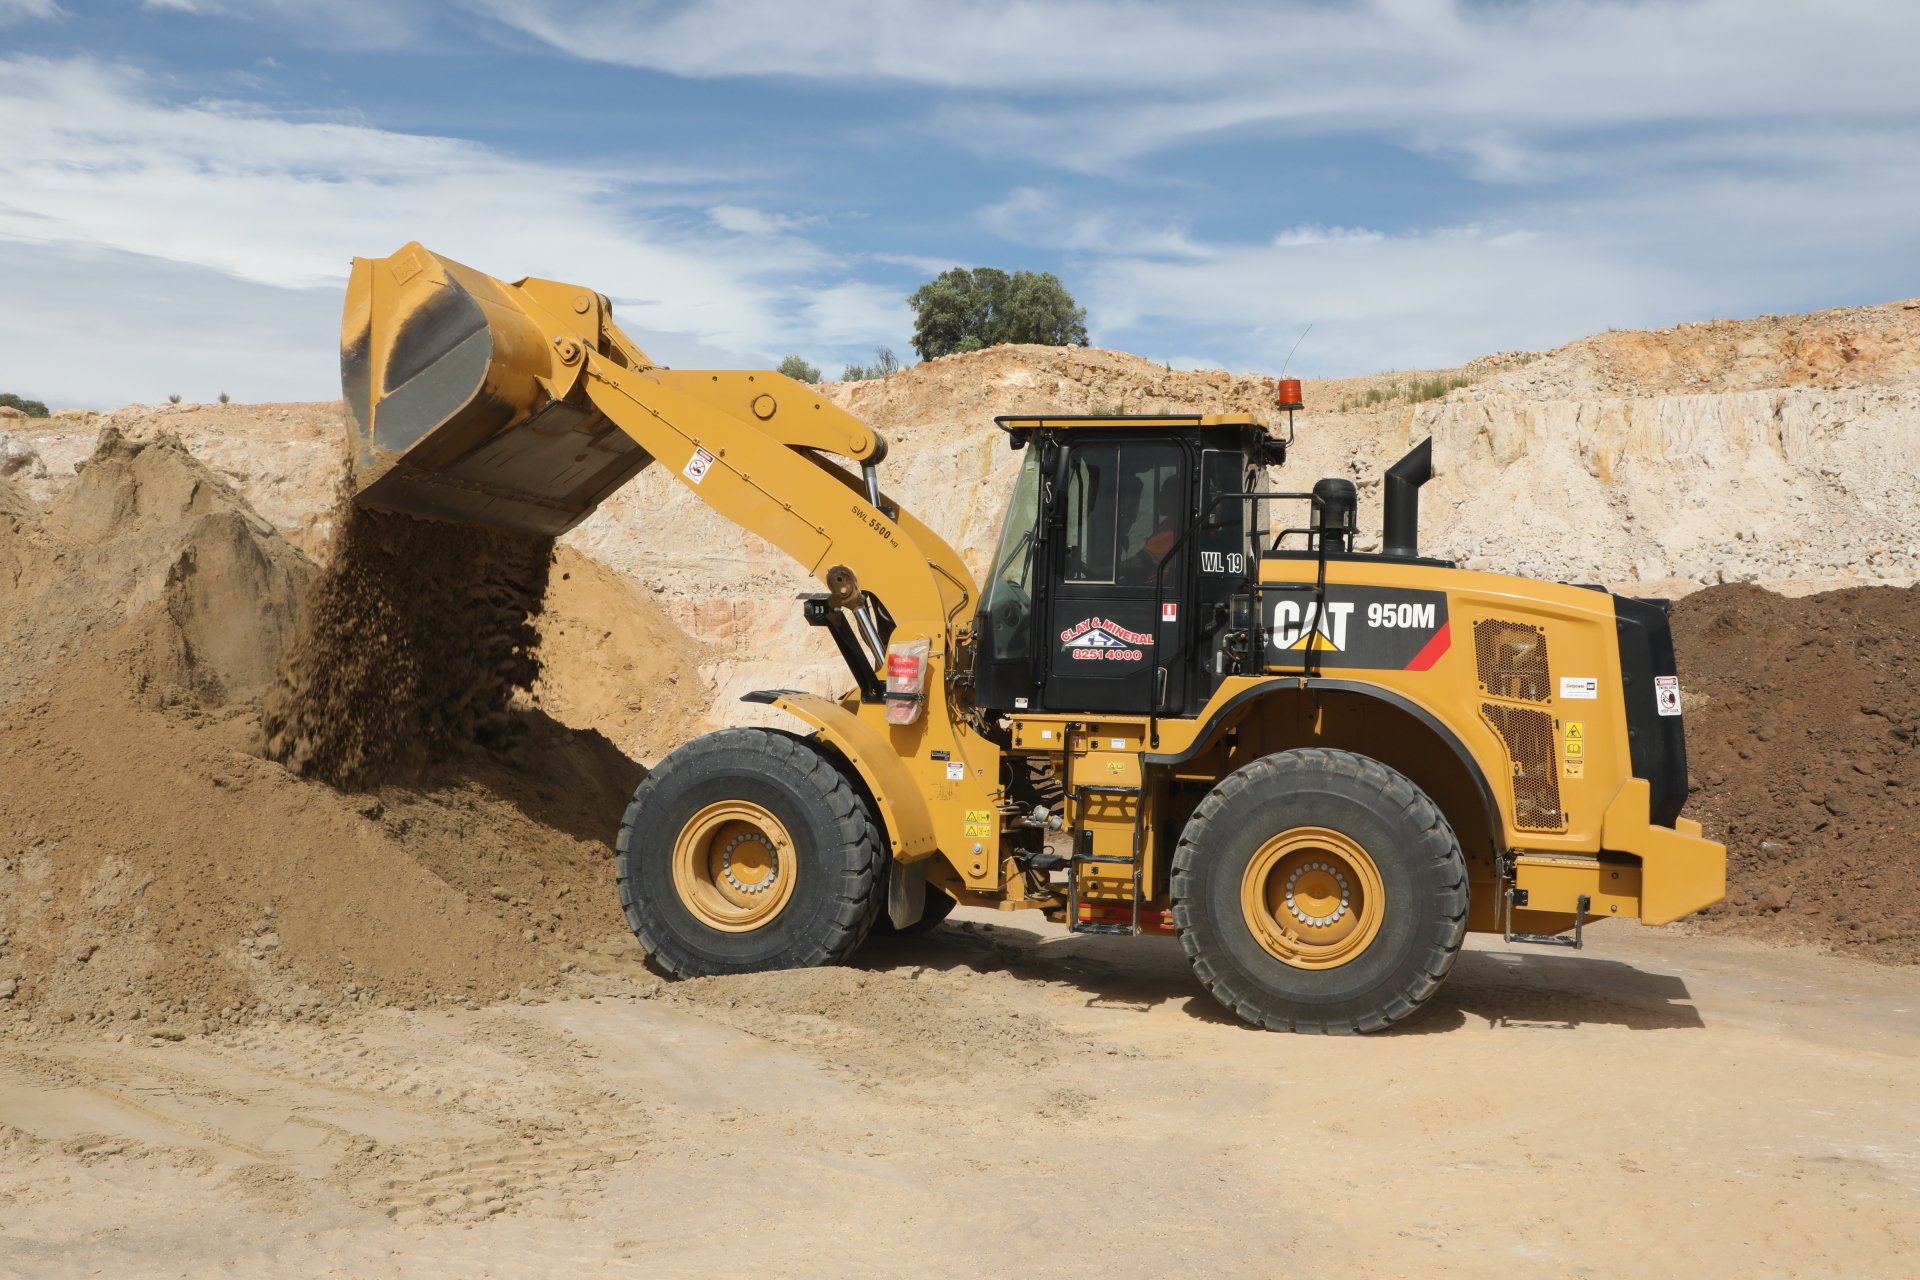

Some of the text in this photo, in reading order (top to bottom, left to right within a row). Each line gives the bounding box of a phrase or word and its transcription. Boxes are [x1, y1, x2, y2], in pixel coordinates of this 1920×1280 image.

[851, 505, 899, 548] SWL 5500 kg
[1201, 551, 1243, 574] WL 19
[1060, 616, 1155, 645] CLAY & MINERAL
[1272, 600, 1436, 652] CAT 950M
[1072, 649, 1143, 661] 8251 4000
